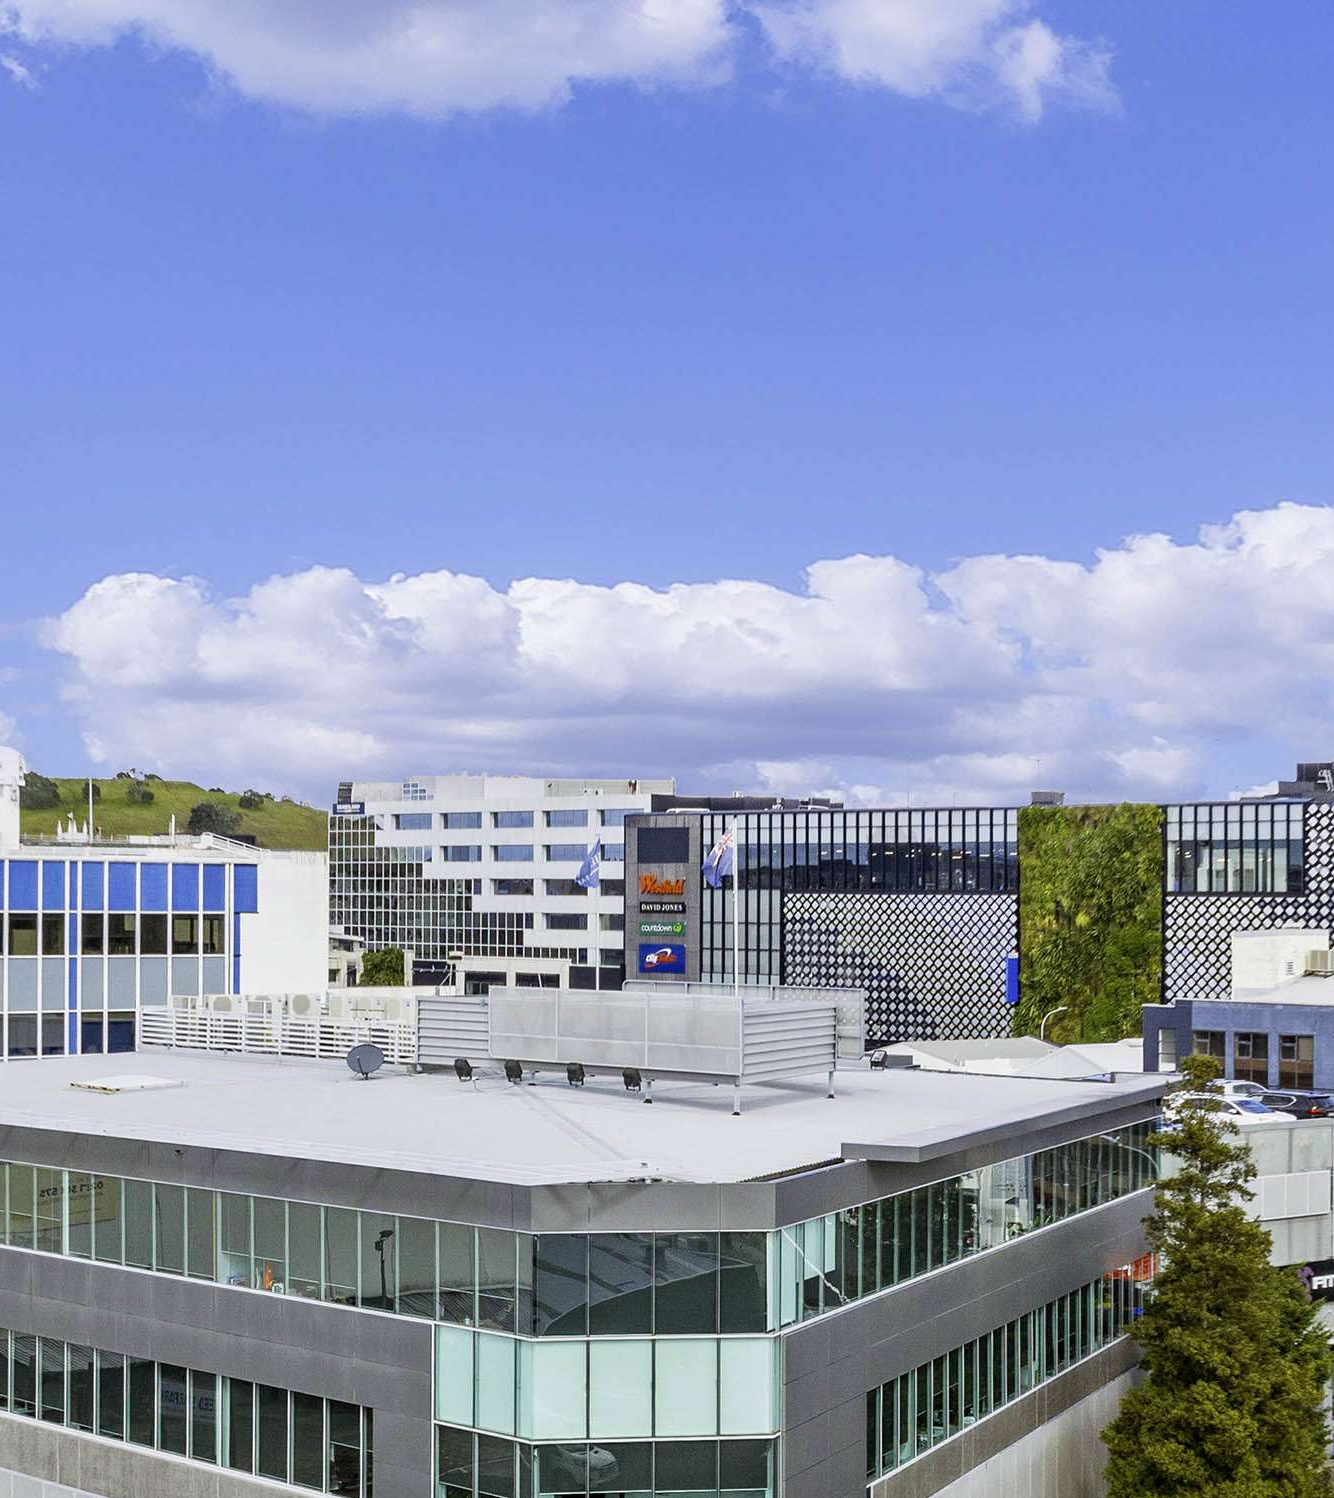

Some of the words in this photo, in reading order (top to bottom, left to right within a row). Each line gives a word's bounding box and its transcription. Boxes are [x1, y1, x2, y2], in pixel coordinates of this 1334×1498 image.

[641, 903, 661, 911] DAVID
[662, 903, 682, 911] JONES
[641, 923, 672, 932] countdown
